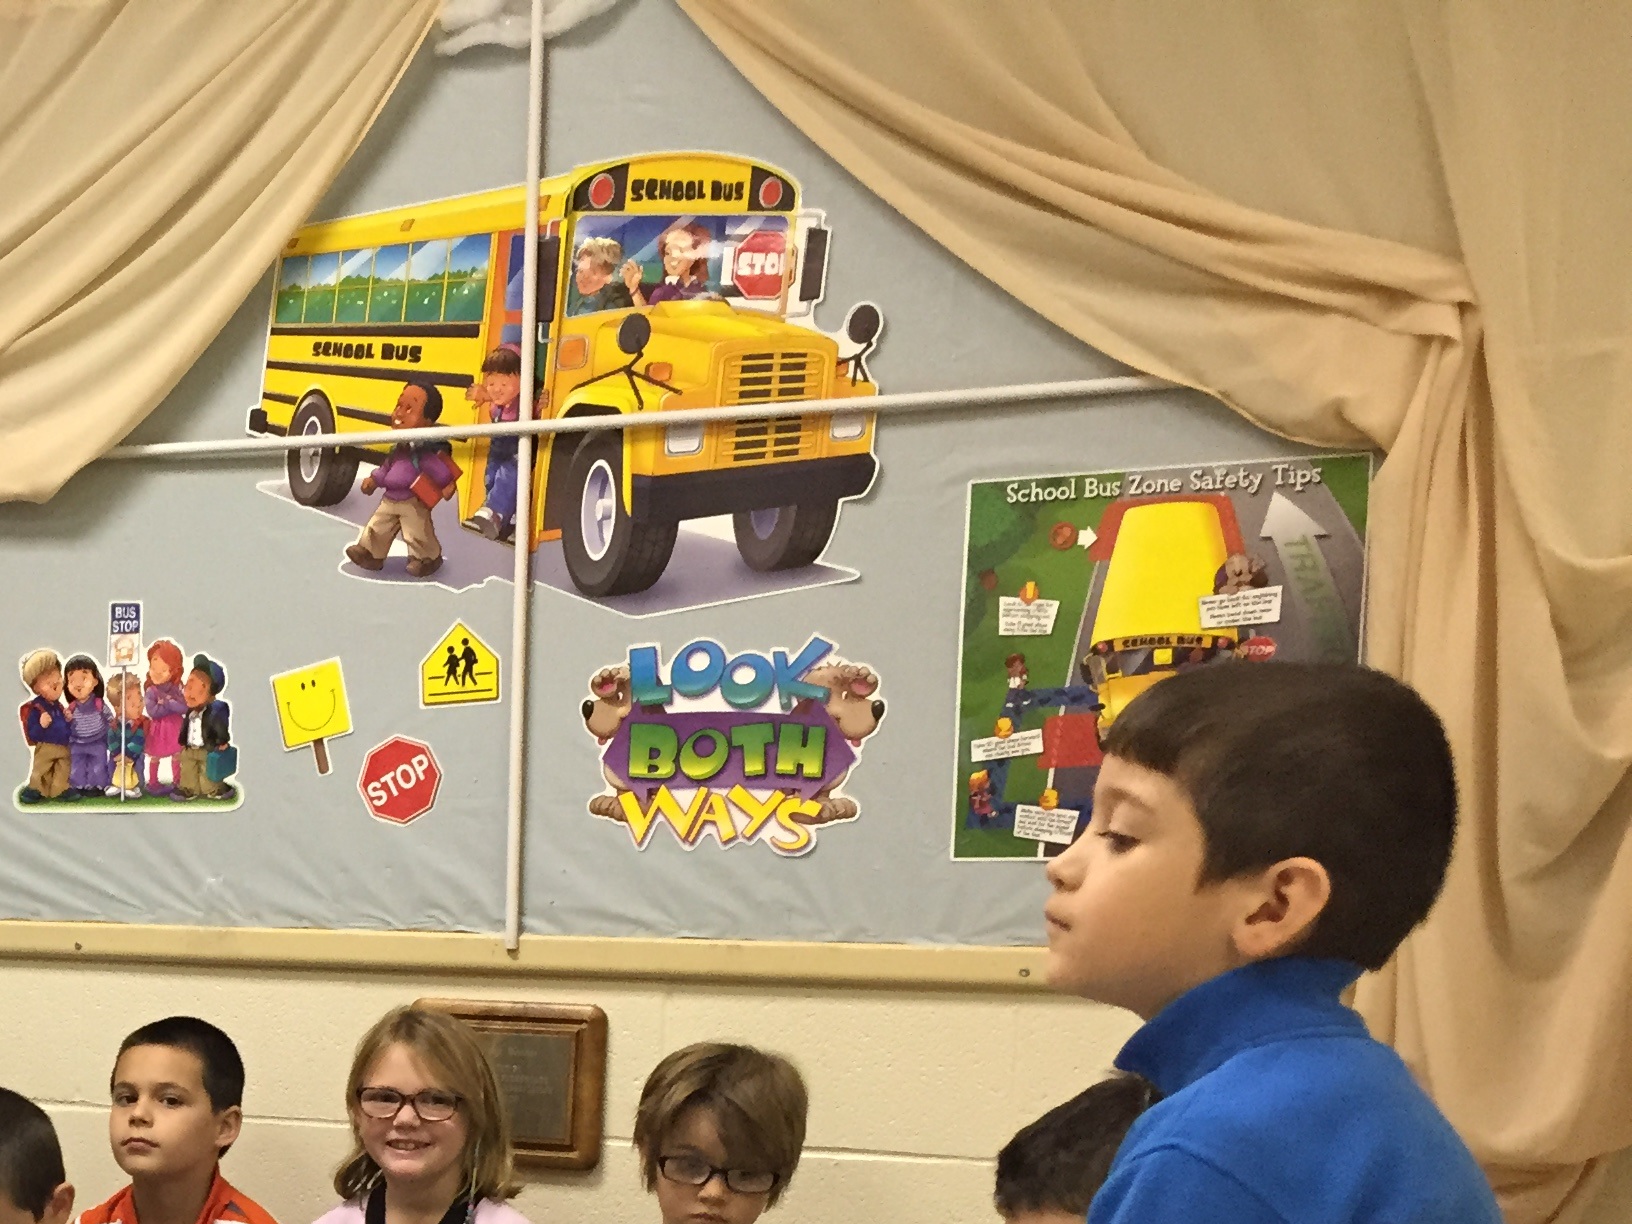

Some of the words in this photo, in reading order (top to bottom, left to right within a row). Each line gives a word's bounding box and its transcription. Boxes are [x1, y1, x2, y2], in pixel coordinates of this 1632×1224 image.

[631, 178, 706, 201] SCHOOL
[711, 180, 744, 201] BUS
[312, 341, 375, 360] SCHOOL
[381, 343, 422, 363] BUS
[1006, 477, 1076, 504] School
[1084, 477, 1121, 499] Bus
[1129, 474, 1182, 495] Zone
[1190, 467, 1263, 494] Safety
[1272, 463, 1322, 492] Tips
[112, 619, 139, 633] STOP
[115, 606, 136, 619] BUS
[629, 636, 833, 711] LOOK
[628, 721, 827, 781] BOTH
[367, 753, 429, 806] STOP
[618, 783, 823, 851] WAYS
